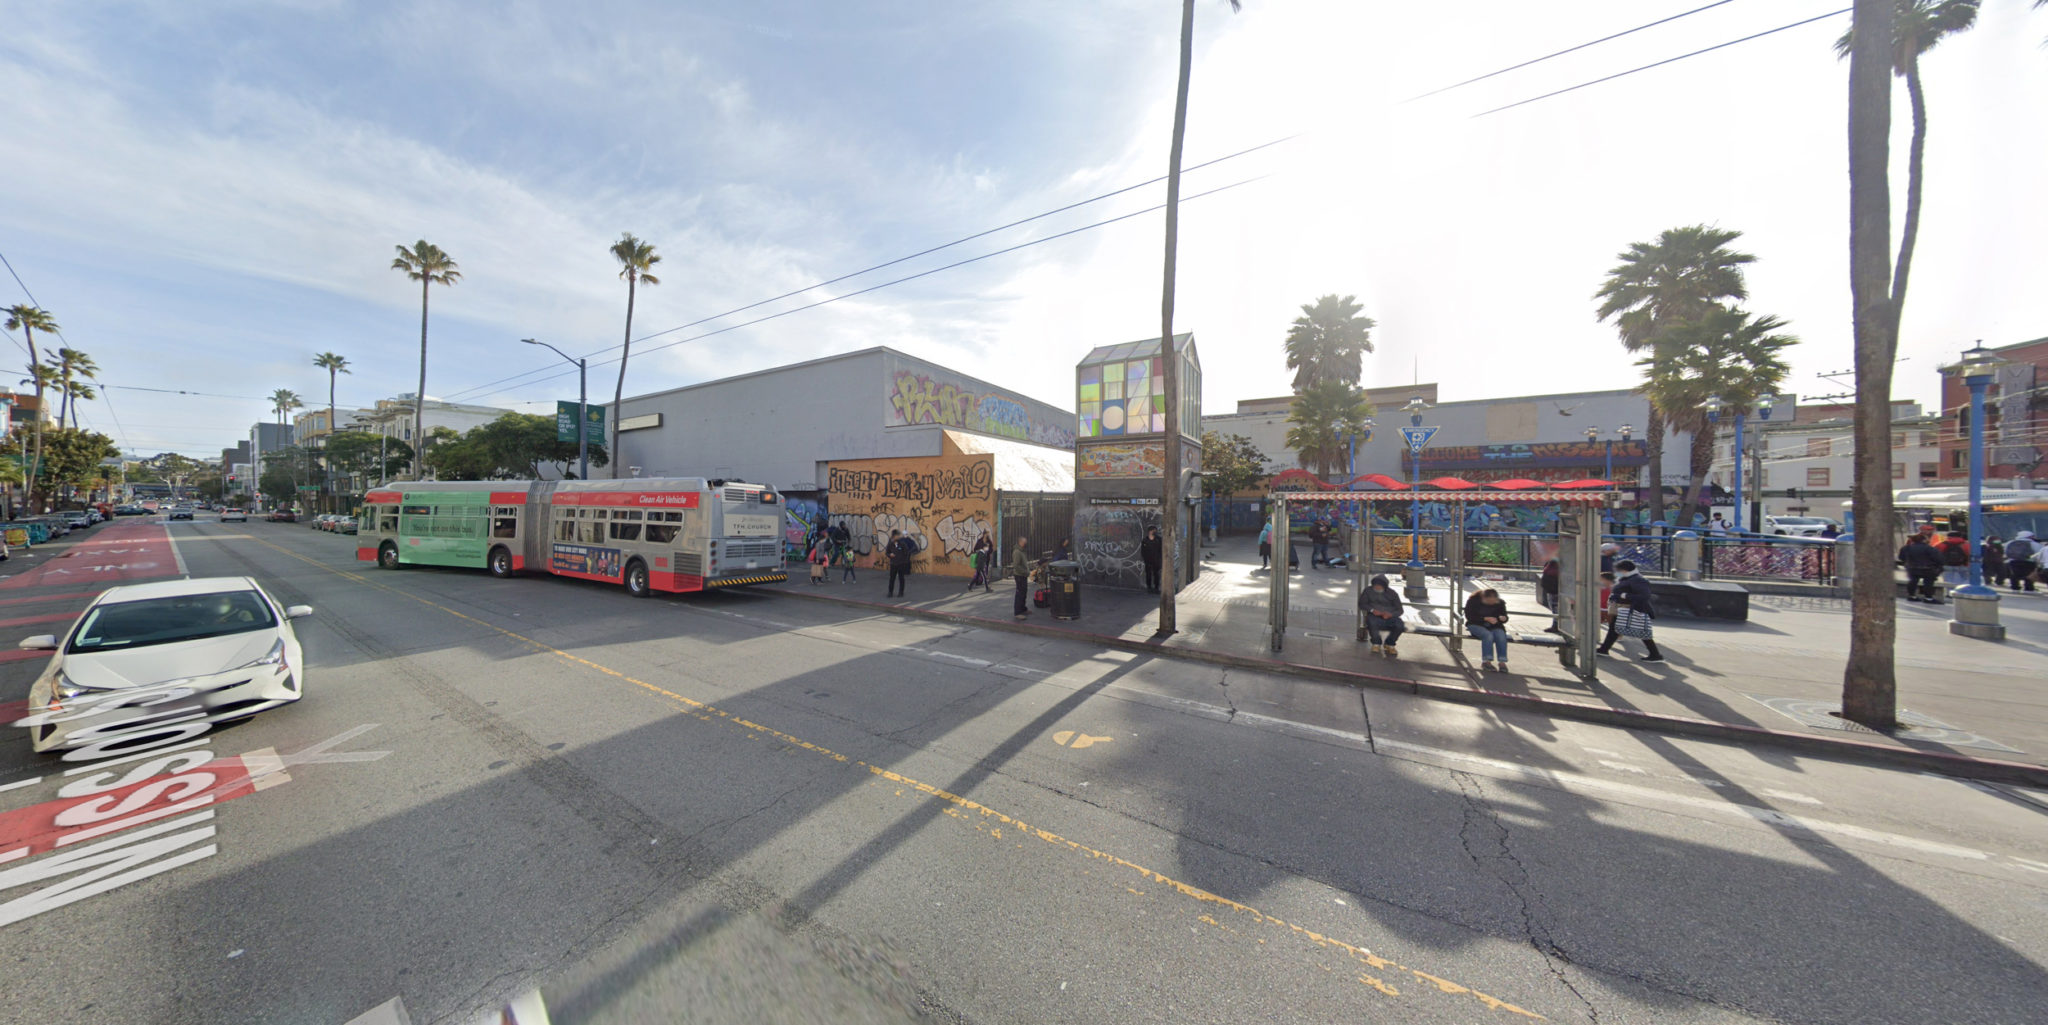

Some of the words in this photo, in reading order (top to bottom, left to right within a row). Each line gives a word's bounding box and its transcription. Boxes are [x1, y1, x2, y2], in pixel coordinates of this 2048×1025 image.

[640, 495, 656, 504] Clean
[656, 496, 665, 504] Air
[666, 496, 687, 505] Vehicle
